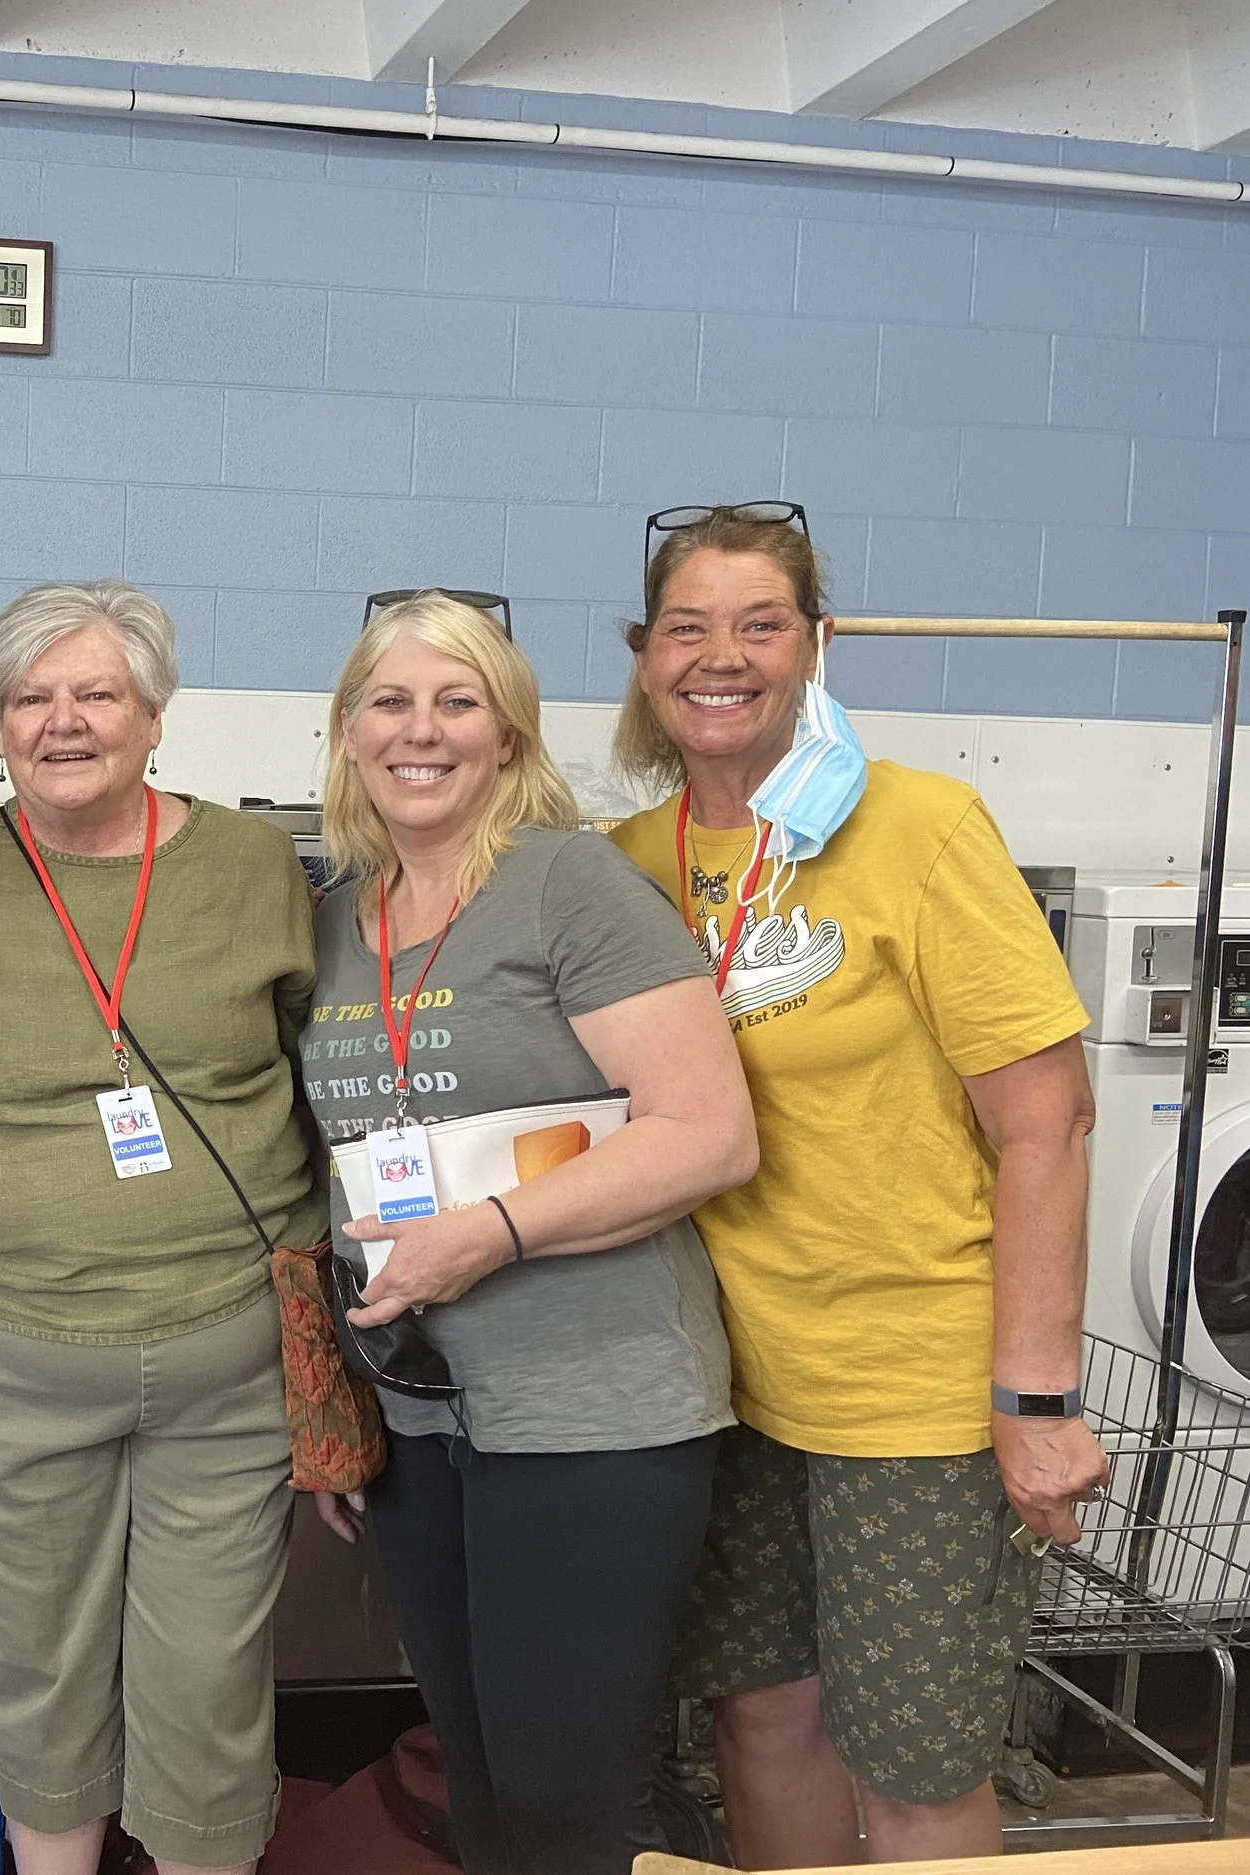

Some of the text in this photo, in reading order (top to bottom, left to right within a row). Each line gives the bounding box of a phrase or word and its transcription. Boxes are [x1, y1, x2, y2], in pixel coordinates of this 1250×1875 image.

[335, 1003, 378, 1022] THE
[746, 1010, 769, 1029] Est
[772, 994, 808, 1018] 2019
[327, 1036, 366, 1059] THE
[373, 1028, 452, 1053] GOD
[307, 1080, 326, 1100] BE
[328, 1076, 371, 1099] THE
[113, 1139, 162, 1155] VOLUNTEER
[380, 1201, 434, 1216] VOLUNTEER
